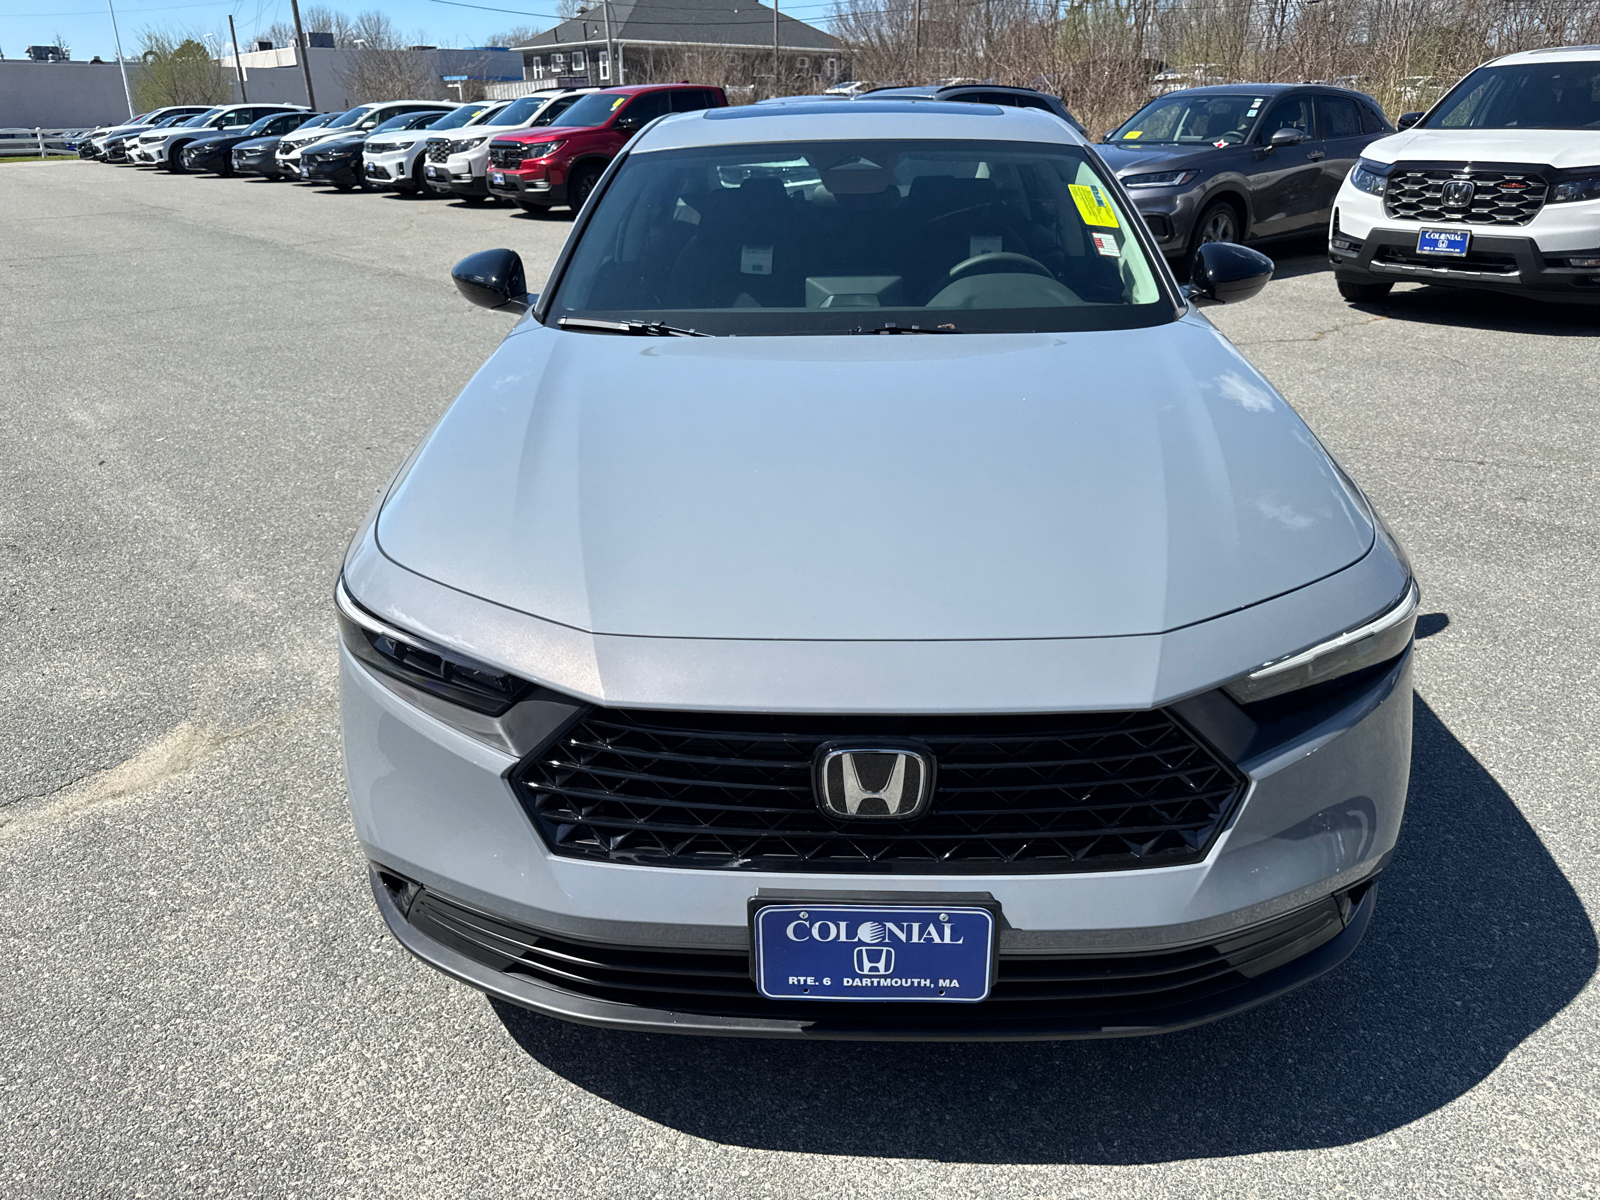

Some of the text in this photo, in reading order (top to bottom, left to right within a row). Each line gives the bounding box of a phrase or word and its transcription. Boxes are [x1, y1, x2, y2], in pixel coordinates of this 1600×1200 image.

[1425, 232, 1463, 241] COLONIAL
[786, 920, 964, 945] COLONIAL
[788, 976, 960, 989] RTE. 6 DARTMOUTH, MA
